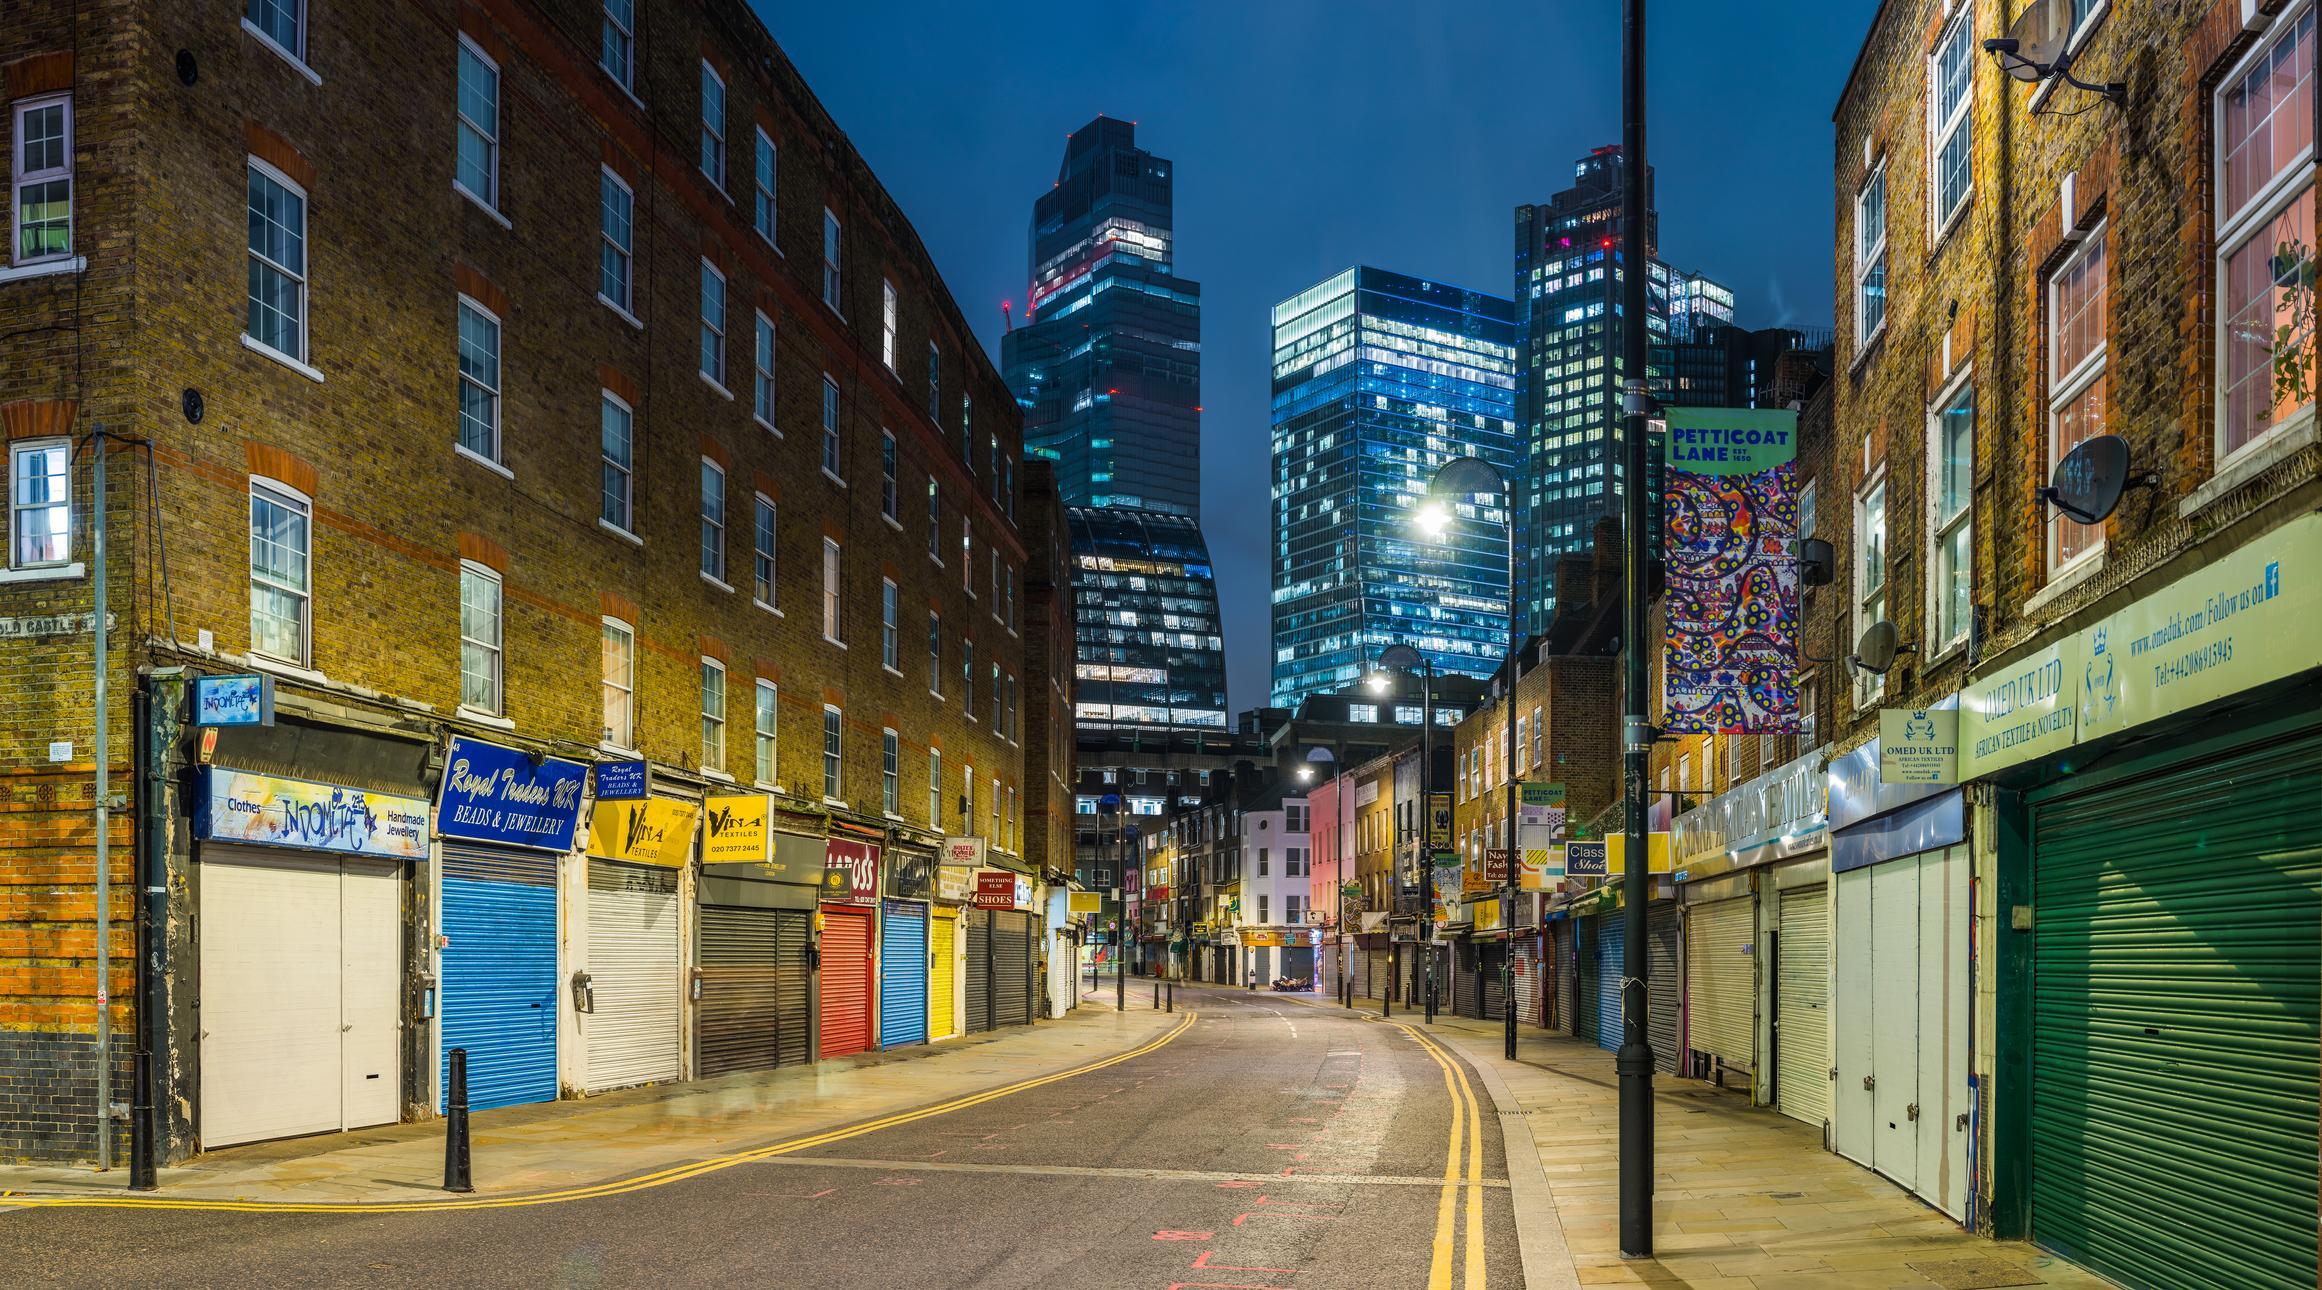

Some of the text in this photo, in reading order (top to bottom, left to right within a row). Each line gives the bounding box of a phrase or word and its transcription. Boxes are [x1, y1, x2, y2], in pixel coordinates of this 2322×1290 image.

[1673, 428, 1788, 445] PETTICOAT
[1673, 445, 1728, 461] LANE
[2240, 588, 2250, 611] us
[2252, 583, 2264, 606] on
[26, 618, 74, 632] CASTLE
[1984, 658, 2062, 724] OMED UK LTD
[1974, 706, 2073, 758] AFRICAN TEXTILE & NOVELTY
[1887, 747, 1916, 755] OMED
[612, 765, 632, 774] Royal
[448, 758, 580, 810] Royal Traders UK
[600, 788, 642, 796] JEWELLERY
[228, 798, 261, 815] Clothes
[388, 810, 425, 826] Handmade
[454, 804, 564, 836] BEADS & JEWELLERY
[387, 826, 420, 840] Jewellery
[632, 847, 658, 858] TEXTILES
[979, 896, 1012, 904] SHOES
